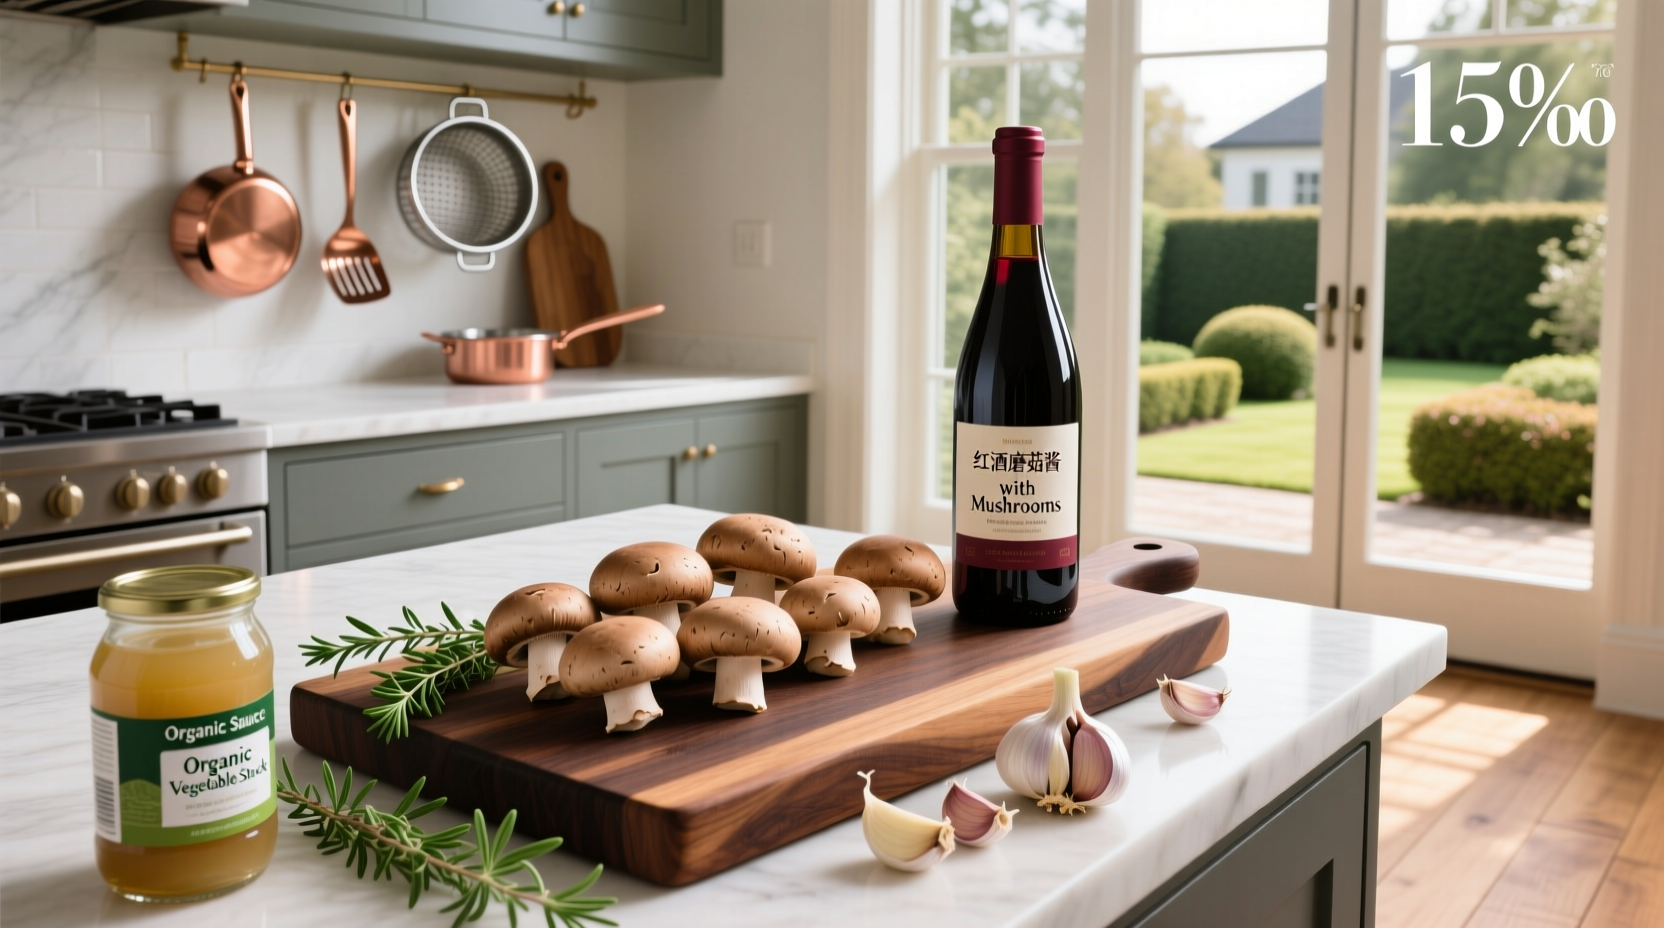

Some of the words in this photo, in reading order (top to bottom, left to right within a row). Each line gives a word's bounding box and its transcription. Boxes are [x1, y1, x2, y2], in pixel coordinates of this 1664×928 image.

[1000, 480, 1035, 496] with
[971, 495, 1061, 514] Mushrooms
[165, 720, 227, 744] Organic
[183, 746, 252, 776] Organic
